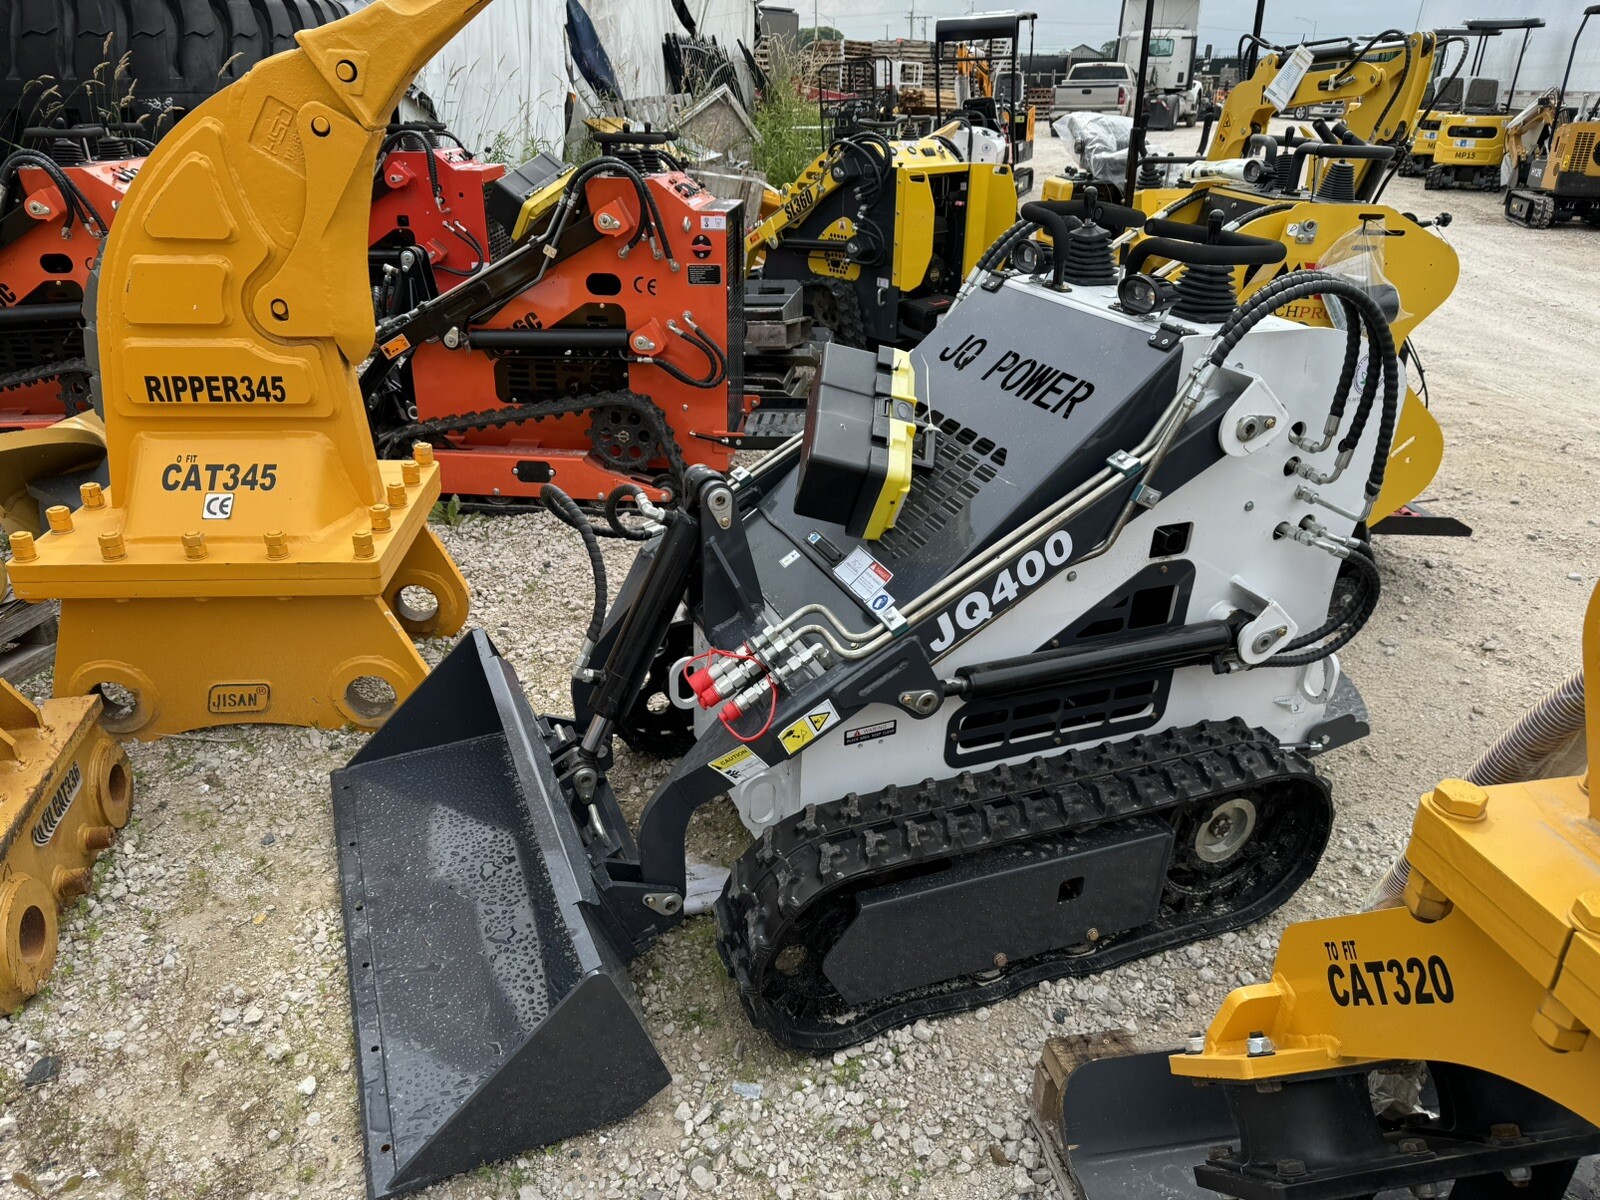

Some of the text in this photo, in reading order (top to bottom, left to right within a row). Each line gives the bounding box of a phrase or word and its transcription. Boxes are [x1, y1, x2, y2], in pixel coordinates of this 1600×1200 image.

[1454, 151, 1476, 160] MP15
[784, 189, 814, 221] SL360
[633, 276, 657, 296] CE
[144, 375, 286, 403] RIPPER345
[939, 334, 1095, 420] JQ POWER
[185, 455, 198, 463] FIT
[162, 463, 277, 491] CAT345
[206, 496, 232, 516] CE
[929, 530, 1073, 653] JQ400
[720, 748, 748, 767] CAUTION
[1324, 940, 1358, 960] TO FIT
[1327, 954, 1454, 1007] CAT320
